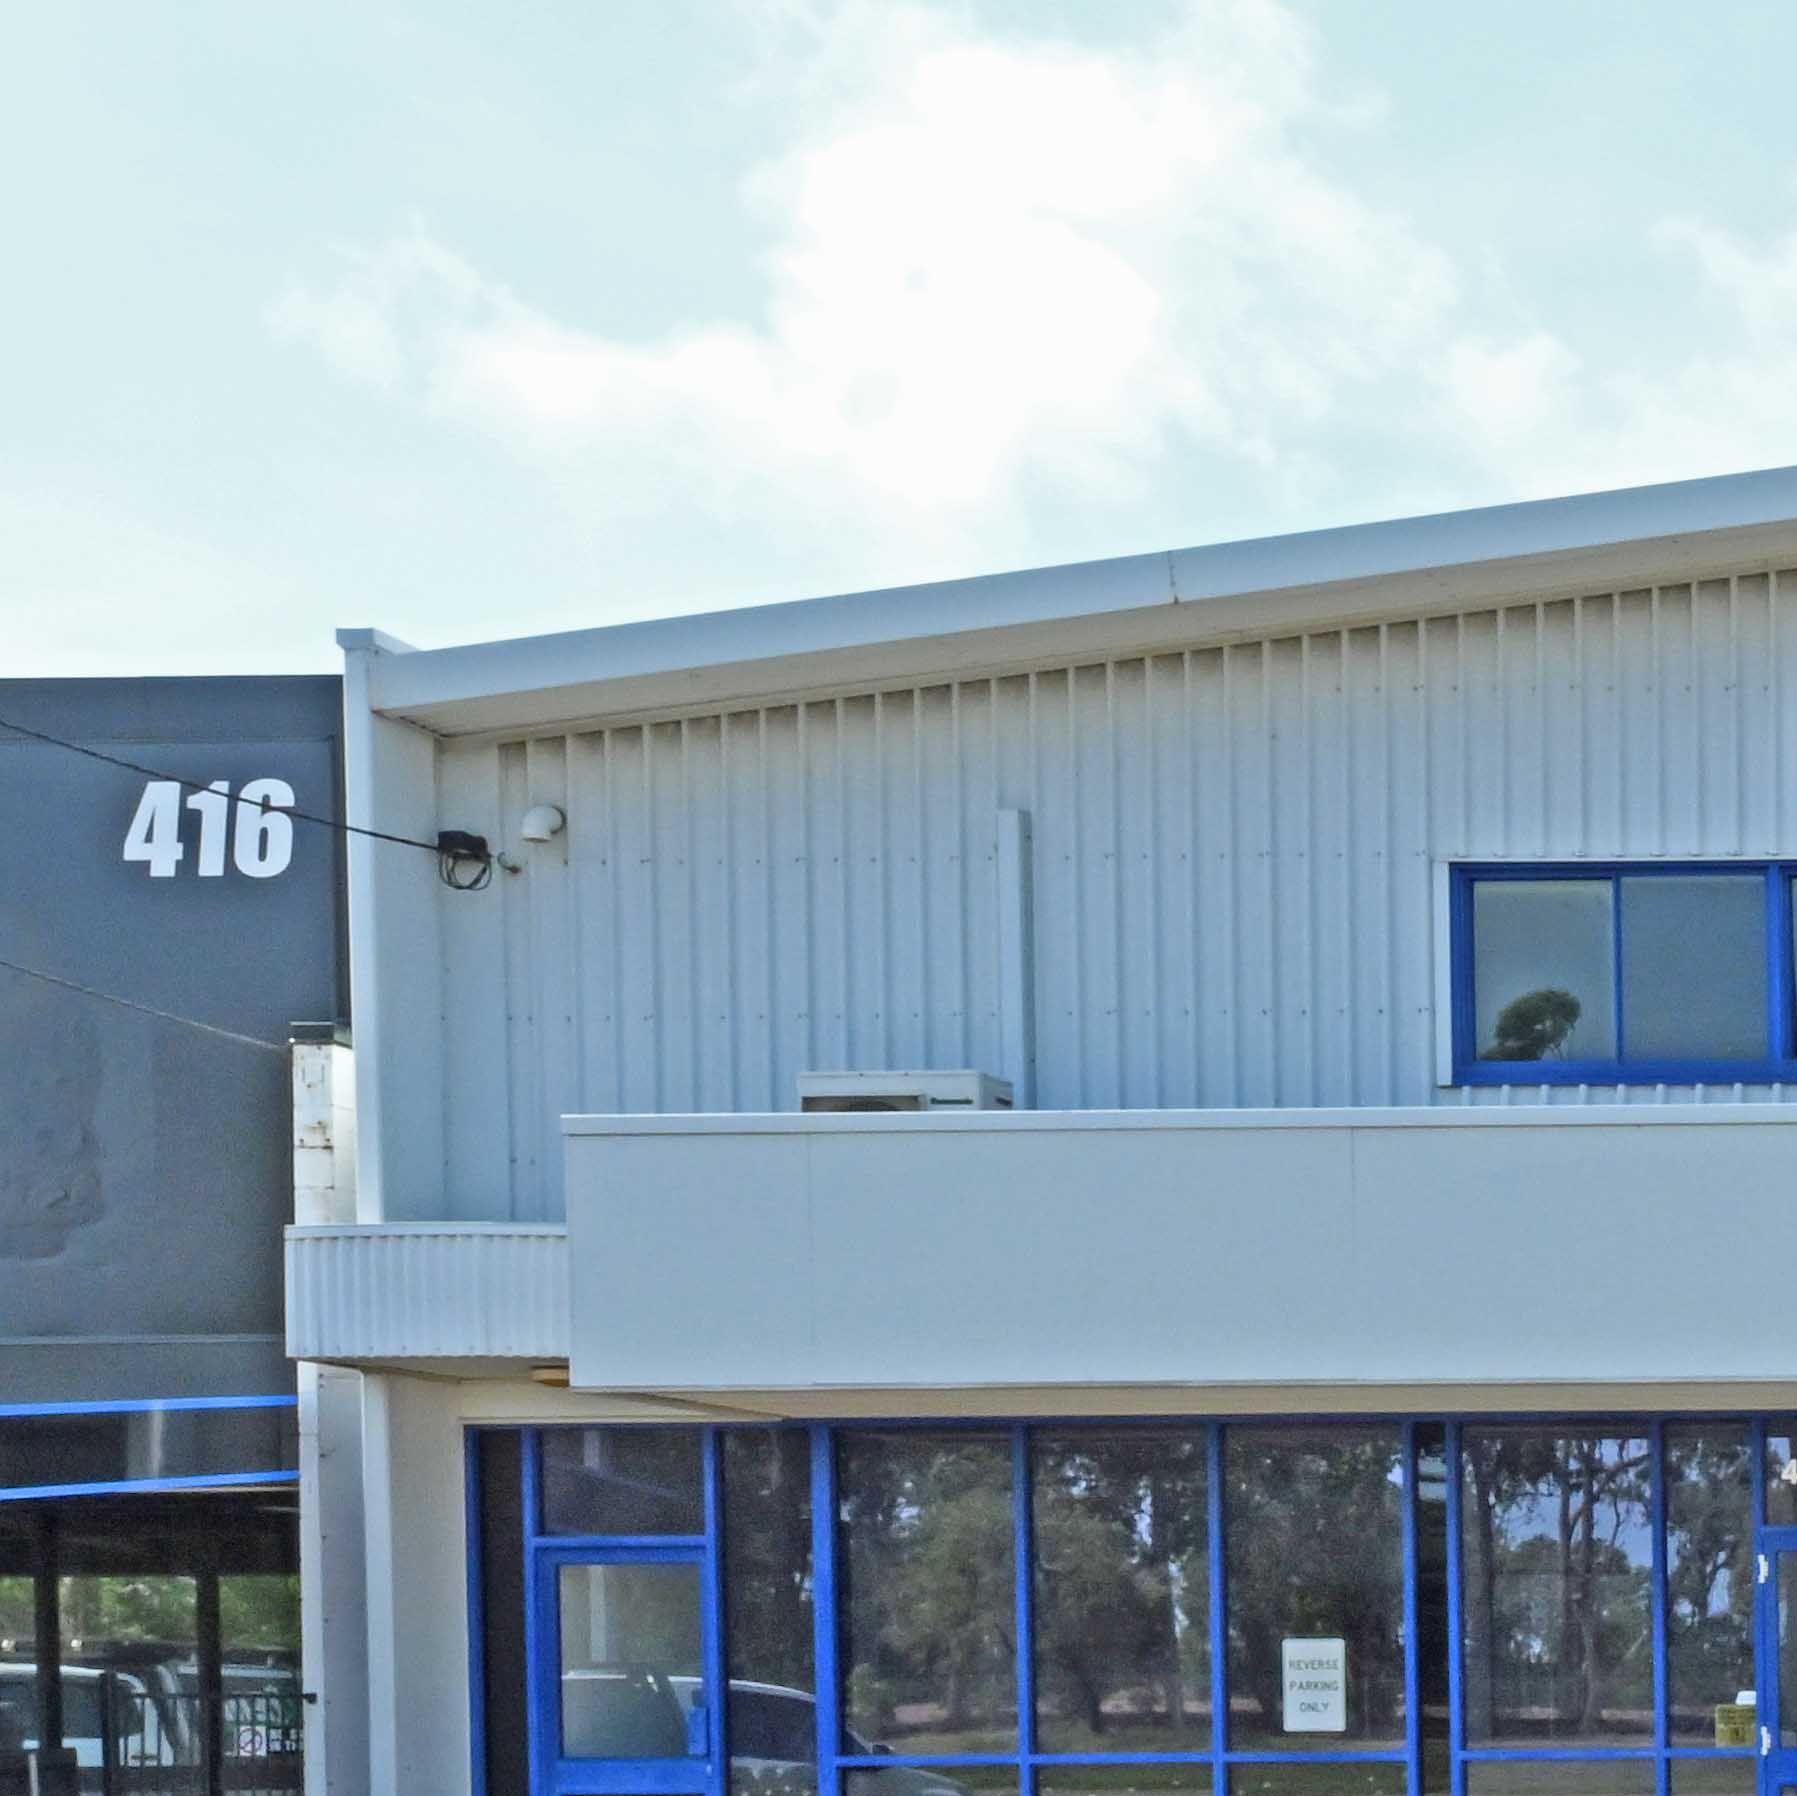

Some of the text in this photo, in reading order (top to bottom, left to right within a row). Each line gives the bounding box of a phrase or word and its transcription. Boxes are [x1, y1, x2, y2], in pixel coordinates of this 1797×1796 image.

[123, 778, 295, 879] 416
[1288, 1659, 1339, 1670] REVERSE
[1288, 1680, 1339, 1691] PARKING
[1299, 1702, 1329, 1712] ONLY
